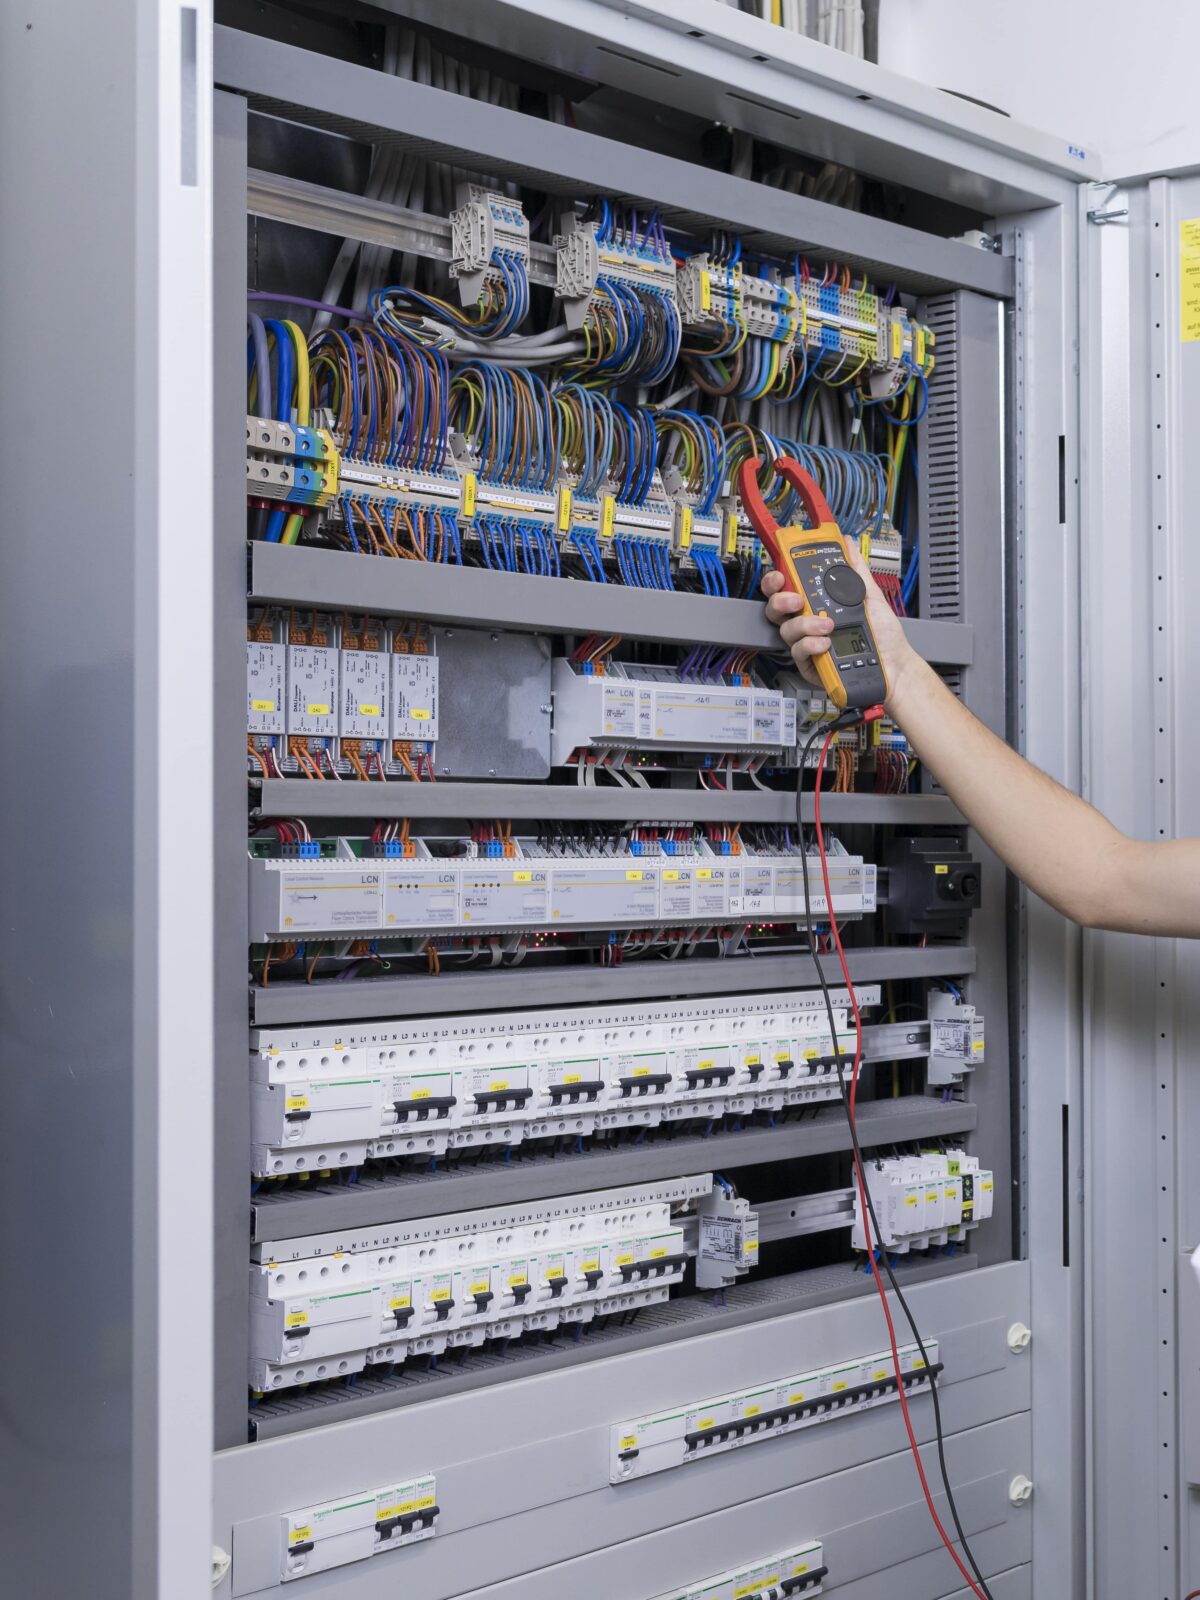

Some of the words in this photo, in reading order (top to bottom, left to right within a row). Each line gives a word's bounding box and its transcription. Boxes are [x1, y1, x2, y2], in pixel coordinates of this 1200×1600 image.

[361, 875, 378, 884] LCN
[439, 875, 455, 883] LCN
[531, 873, 546, 881] LCN
